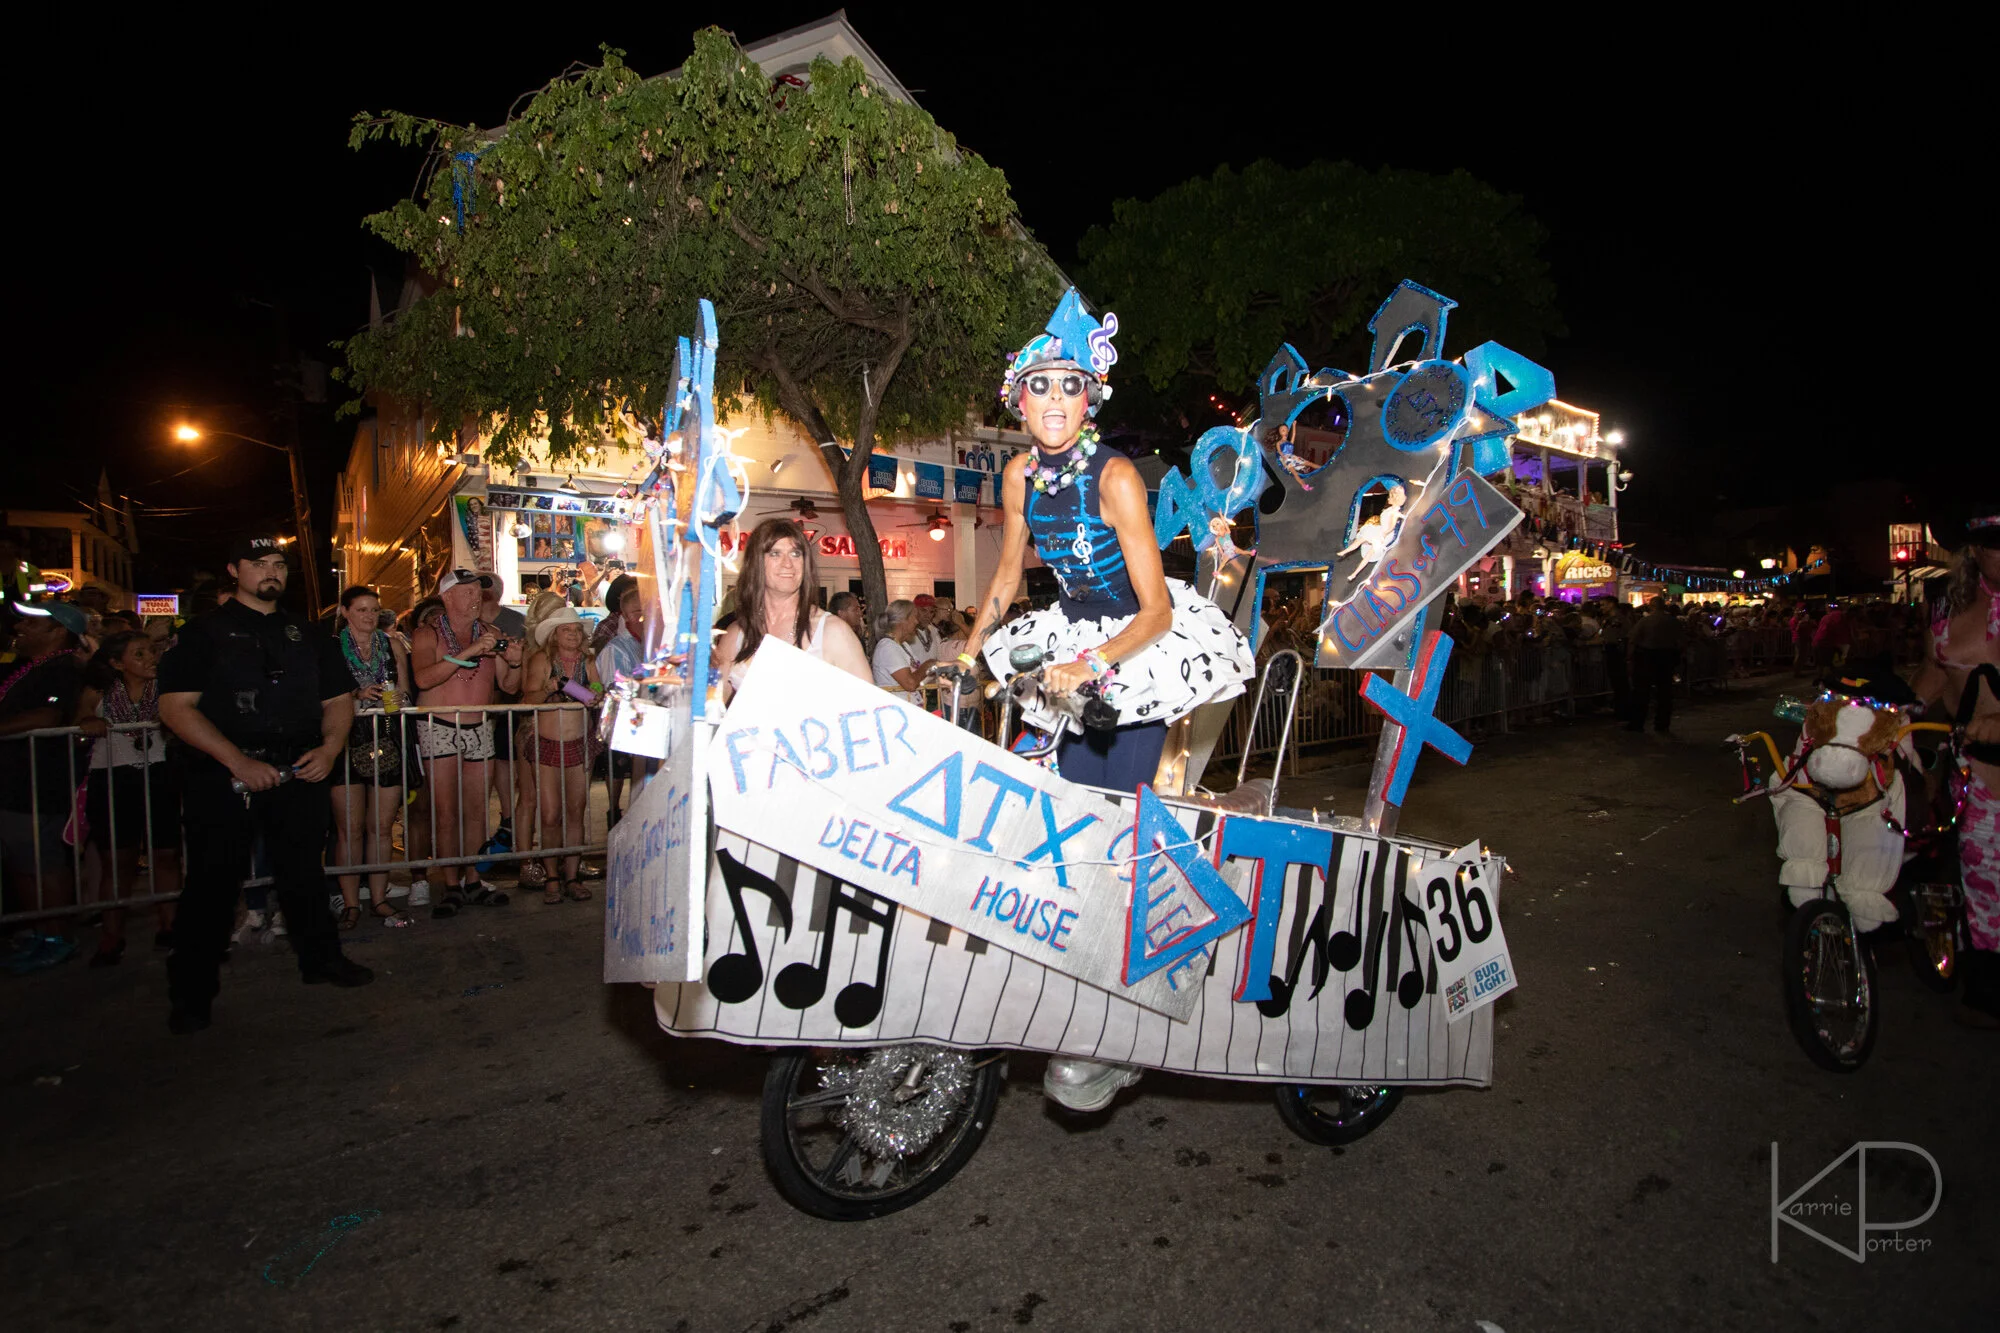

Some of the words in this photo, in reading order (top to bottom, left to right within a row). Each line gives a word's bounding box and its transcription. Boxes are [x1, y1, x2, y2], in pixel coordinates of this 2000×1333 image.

[1421, 476, 1489, 548] 79
[819, 534, 907, 557] SALON
[1412, 535, 1438, 571] of
[1333, 559, 1421, 652] CLASS
[725, 705, 917, 794] FABER
[818, 815, 923, 887] DELTA
[969, 875, 1080, 953] HOUSE
[1426, 860, 1493, 963] 36
[1473, 969, 1507, 997] LIGHT
[1474, 961, 1499, 983] BUD
[1447, 986, 1469, 1014] FEST
